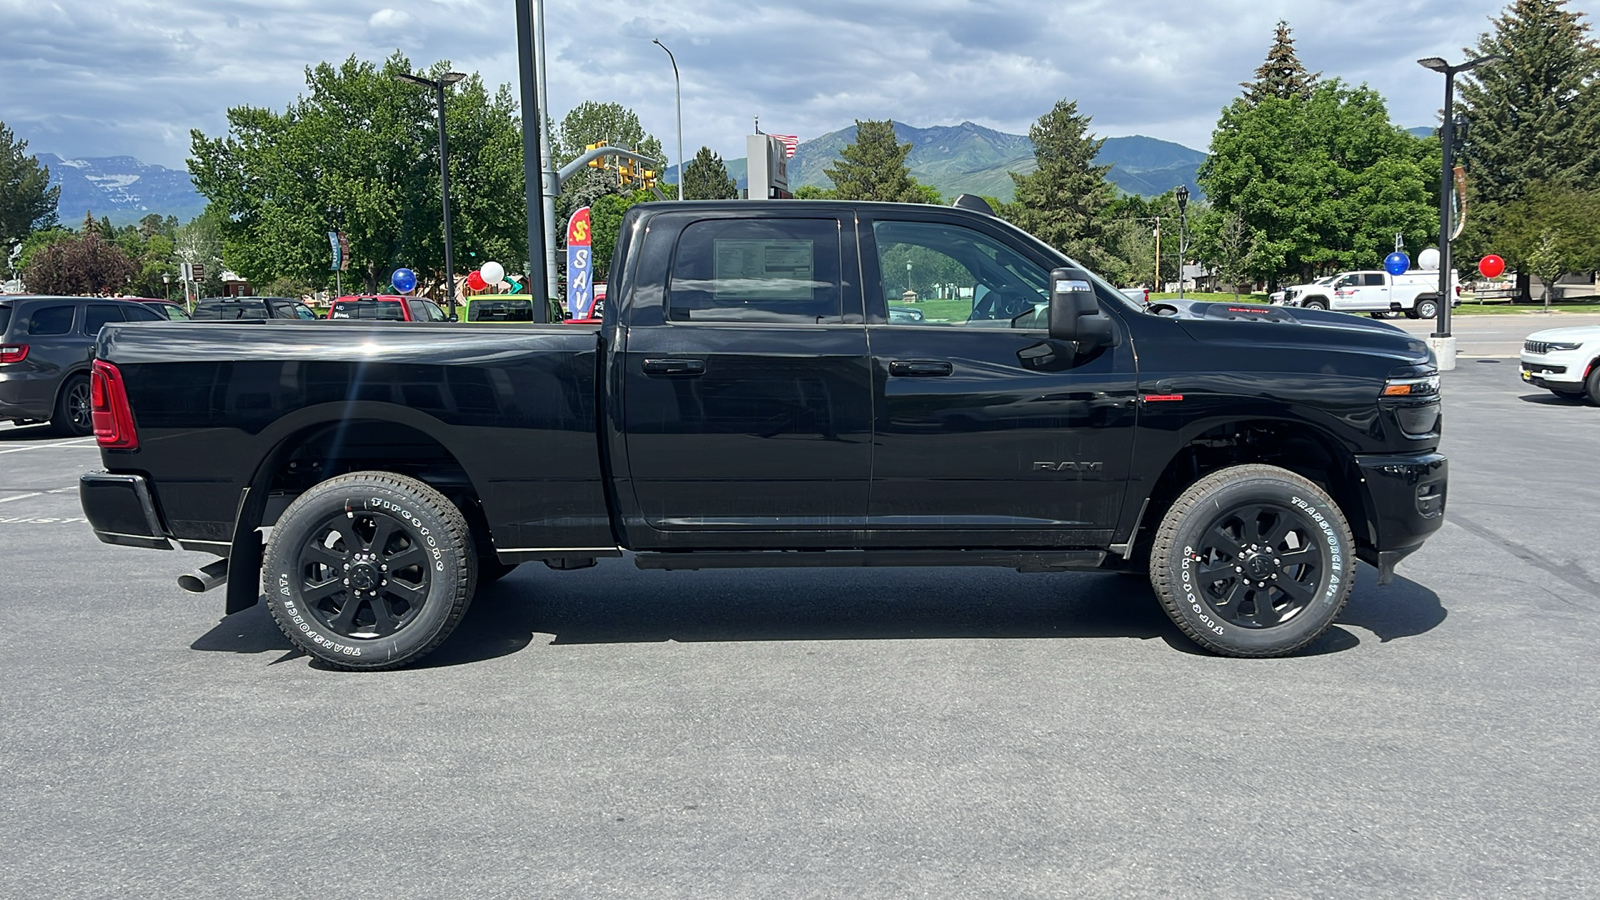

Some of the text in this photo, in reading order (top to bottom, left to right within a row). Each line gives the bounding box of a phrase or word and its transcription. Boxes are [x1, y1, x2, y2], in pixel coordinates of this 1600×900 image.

[1033, 461, 1104, 471] RAM
[371, 497, 444, 572] Firestone
[1291, 496, 1341, 571] TRANSFORCE
[284, 600, 361, 657] TRANSFORCE
